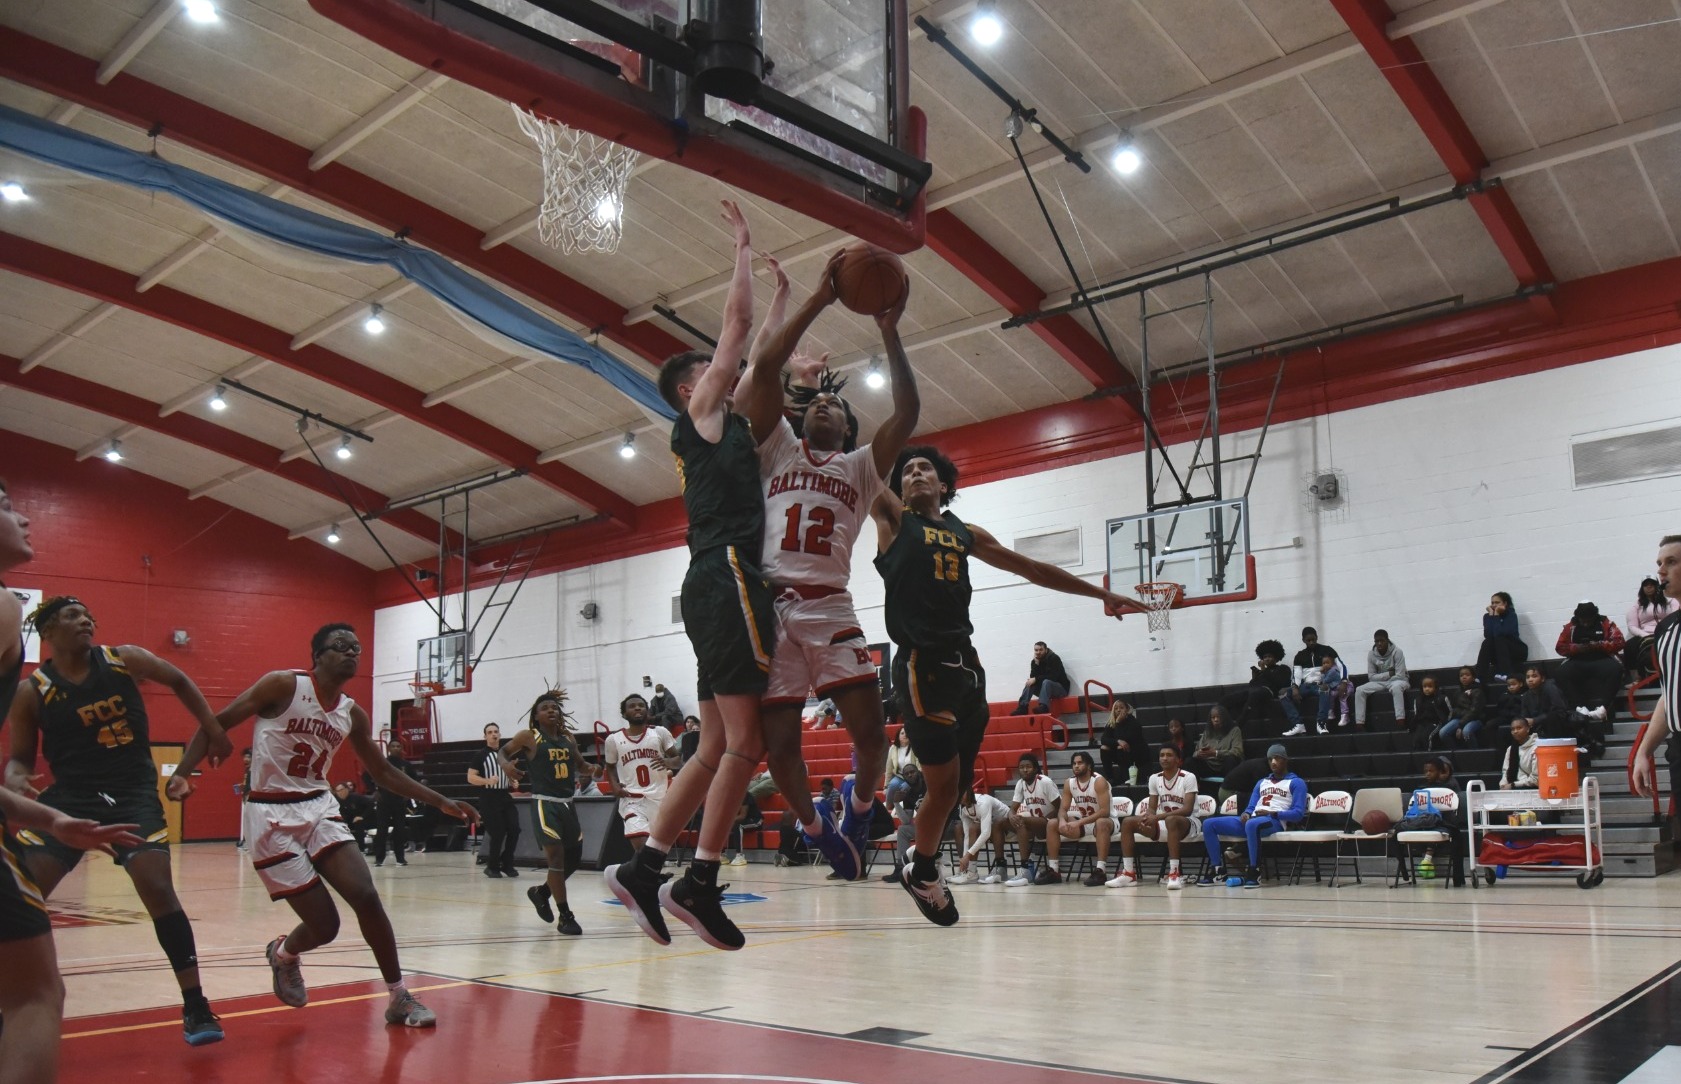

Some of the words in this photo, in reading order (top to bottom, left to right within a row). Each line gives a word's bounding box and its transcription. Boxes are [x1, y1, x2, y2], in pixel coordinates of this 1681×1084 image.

[767, 471, 859, 514] BALTIMORE
[780, 502, 835, 556] 12
[933, 551, 960, 581] 13
[77, 695, 127, 727] FCC
[97, 720, 134, 749] 45
[287, 742, 329, 781] 24
[548, 748, 570, 760] FCC
[554, 763, 569, 779] 10
[636, 764, 651, 787] 0
[1315, 795, 1349, 810] BALTIMORE
[1416, 793, 1454, 807] BALIMORE
